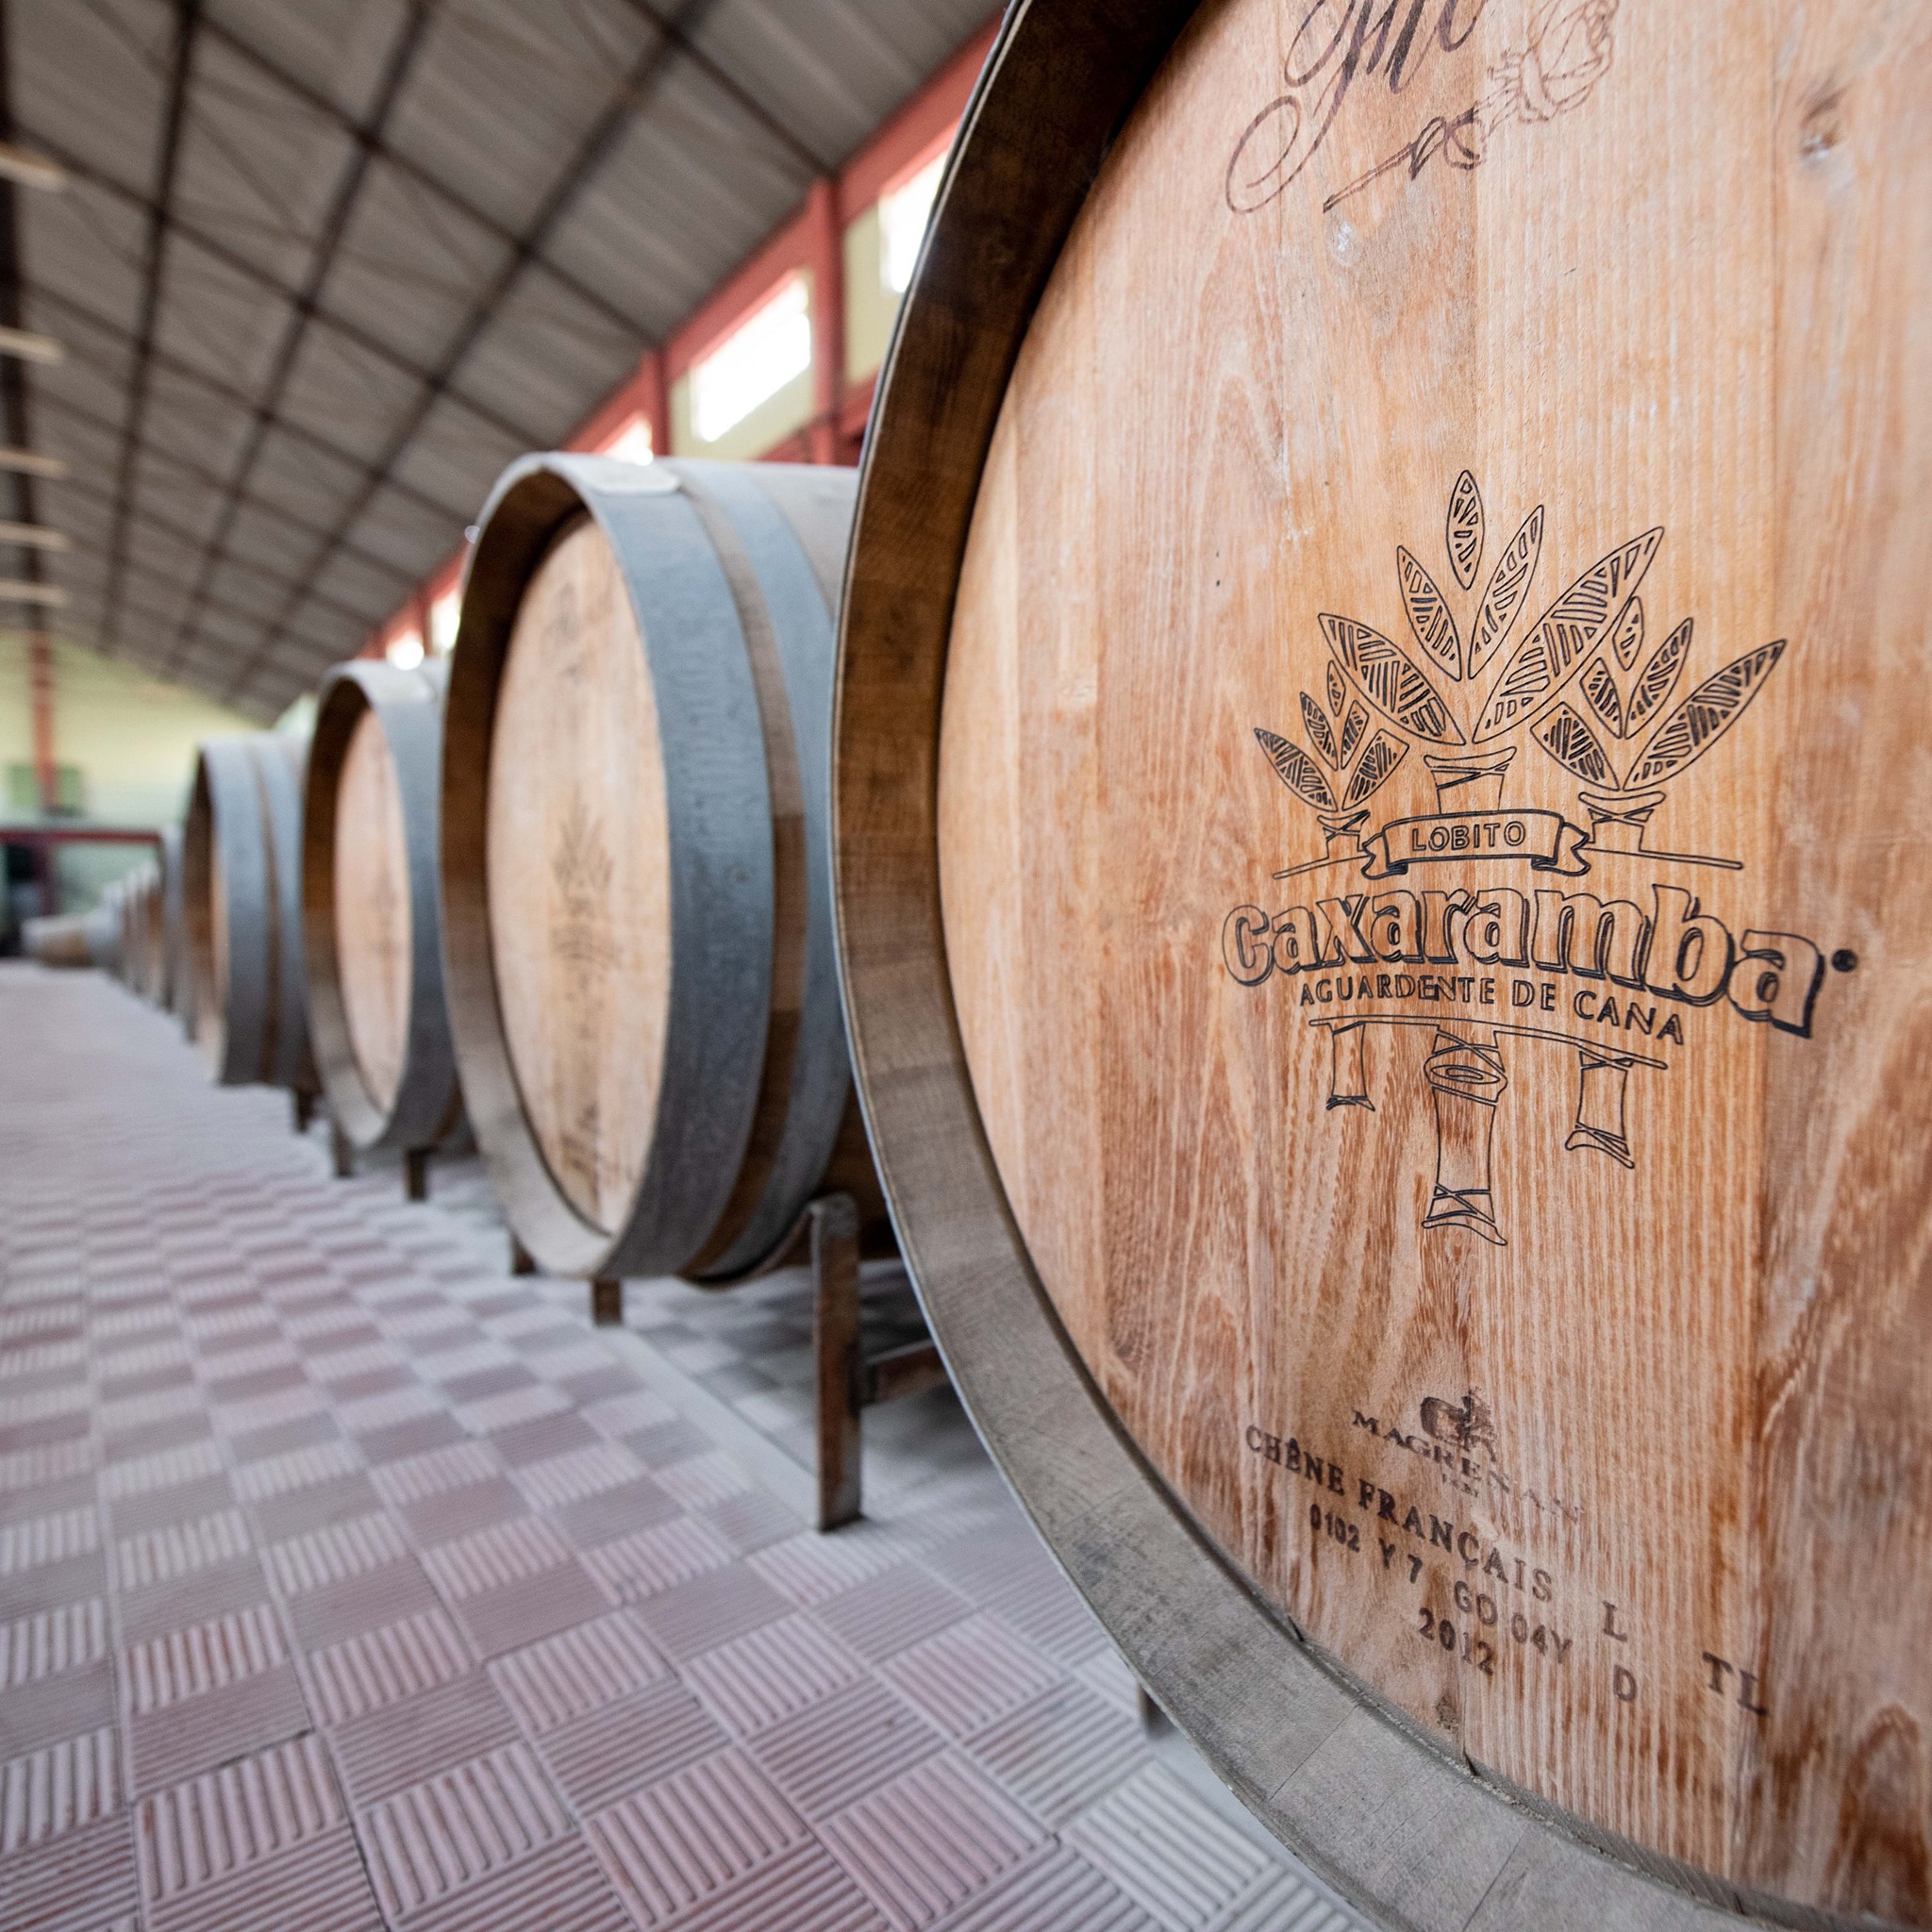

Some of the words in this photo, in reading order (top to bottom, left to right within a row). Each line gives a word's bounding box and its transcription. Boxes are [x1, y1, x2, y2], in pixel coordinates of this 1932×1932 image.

[1411, 821, 1526, 853] LOBITO
[1224, 884, 1826, 1039] Caxaramba
[1300, 973, 1496, 1007] AGUARDENTE
[1511, 979, 1557, 1011] DE
[1573, 990, 1685, 1045] CANA
[1309, 1504, 1360, 1553] 0102
[1418, 1607, 1494, 1676] 2012
